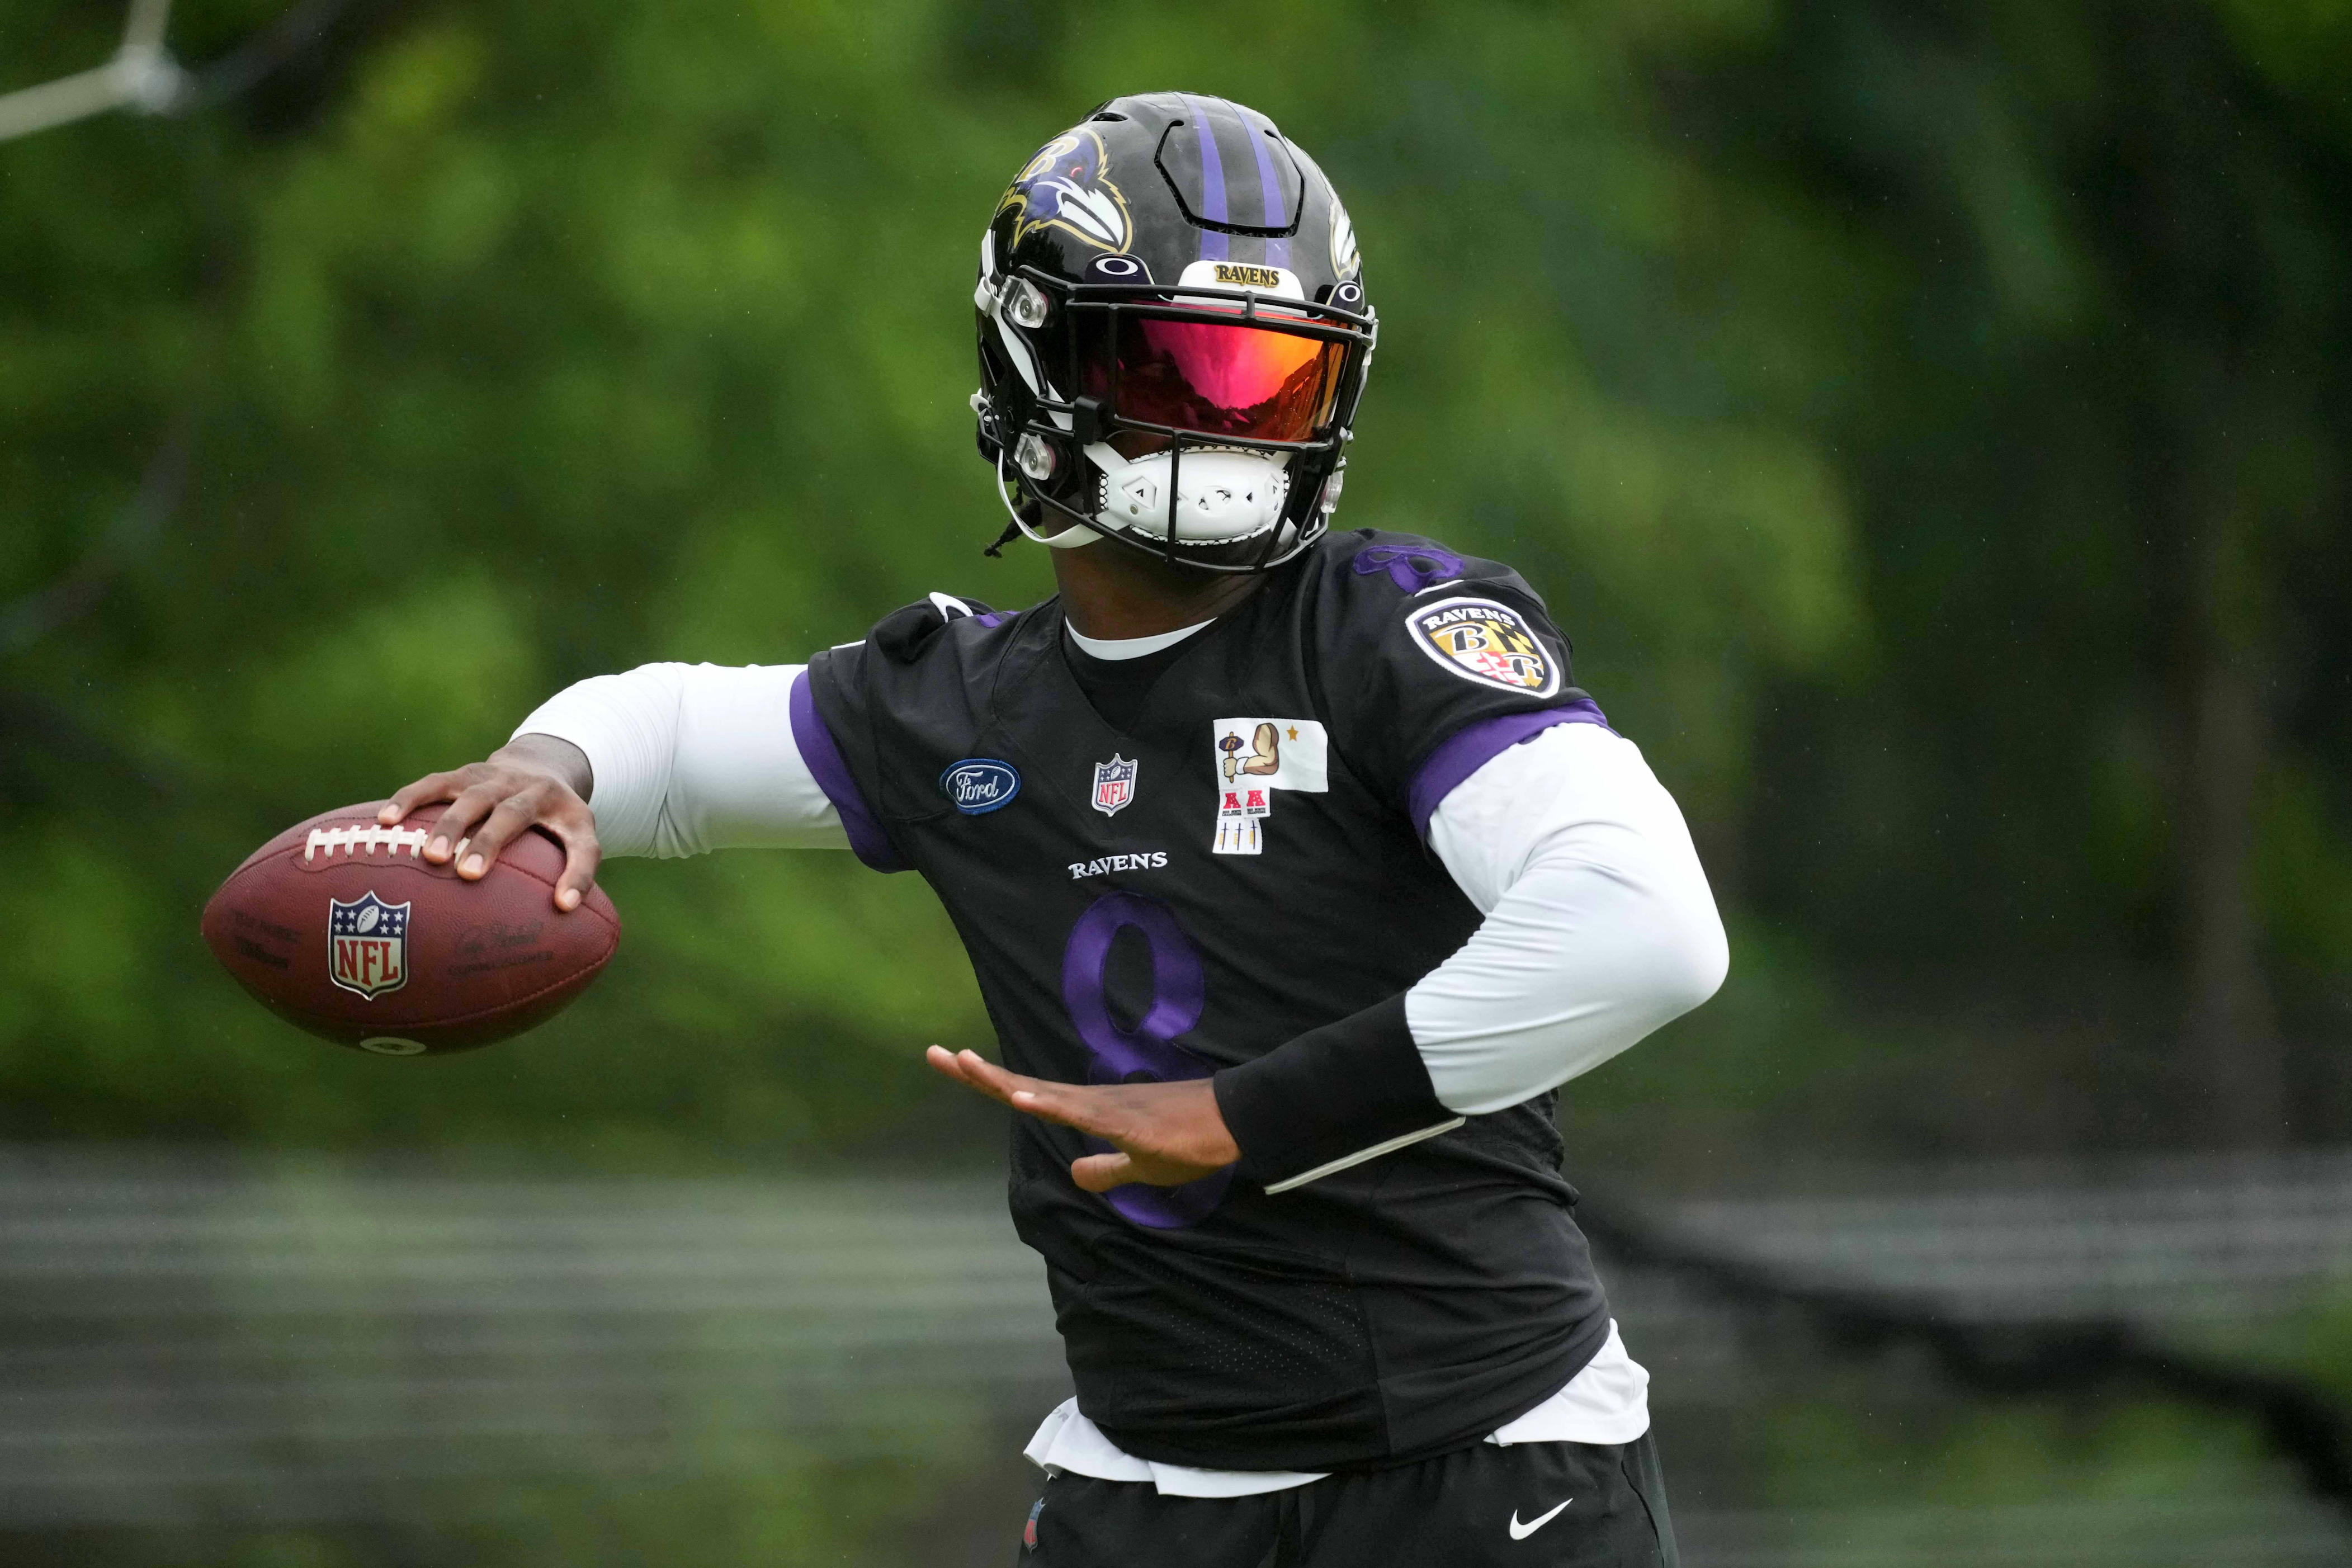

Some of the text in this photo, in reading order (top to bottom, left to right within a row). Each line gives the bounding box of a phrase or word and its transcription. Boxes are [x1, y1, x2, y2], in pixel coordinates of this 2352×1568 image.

[1214, 265, 1279, 287] RAVENS
[1422, 607, 1516, 630] RAVENS
[956, 771, 999, 802] Ford
[1099, 782, 1127, 805] NFL
[1068, 852, 1168, 880] RAVENS
[337, 939, 399, 987] NFL
